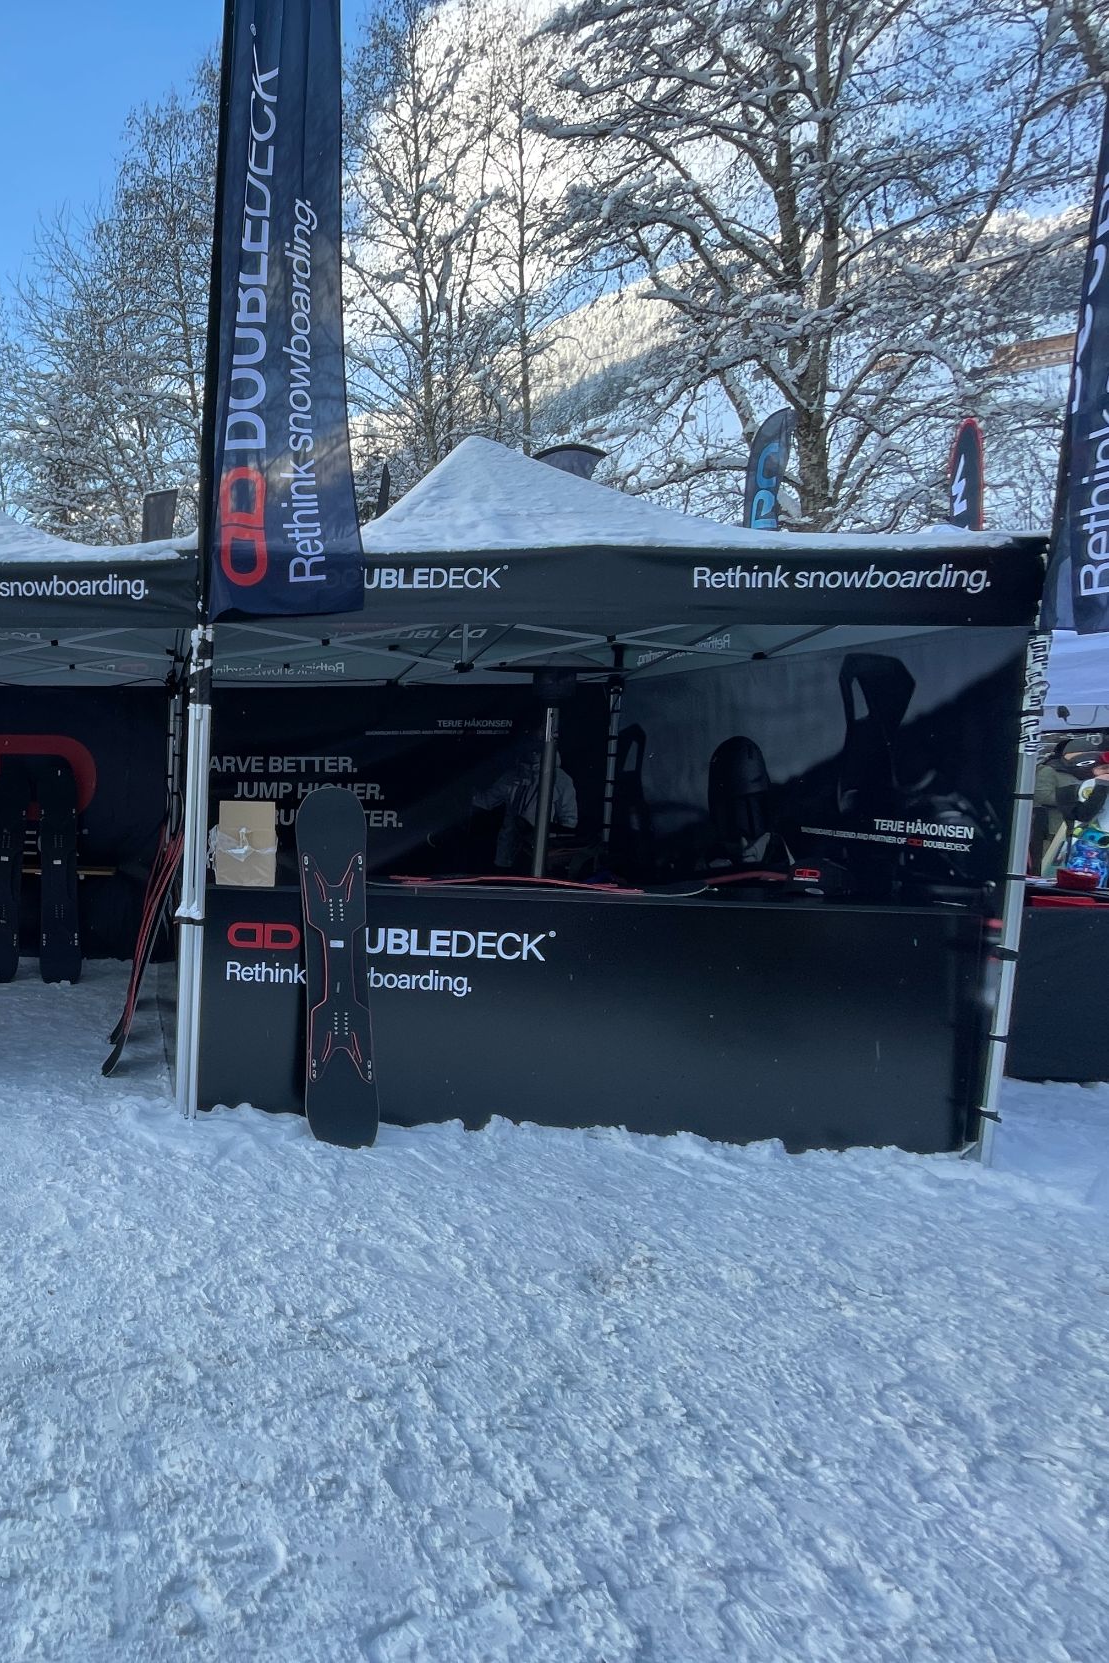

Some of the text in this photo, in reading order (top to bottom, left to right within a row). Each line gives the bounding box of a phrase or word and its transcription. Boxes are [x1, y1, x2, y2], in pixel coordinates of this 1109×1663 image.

[282, 198, 327, 584] Rethink snowboarding.
[363, 566, 502, 590] UBLEDECK
[692, 563, 992, 594] Rethink snowboarding.
[209, 755, 359, 774] ARVE BETTER.
[234, 781, 293, 799] JUMP
[873, 818, 975, 840] TERJE HÅKONSEN
[365, 926, 547, 962] UBLEDECK
[225, 960, 472, 998] Rethink boarding.
